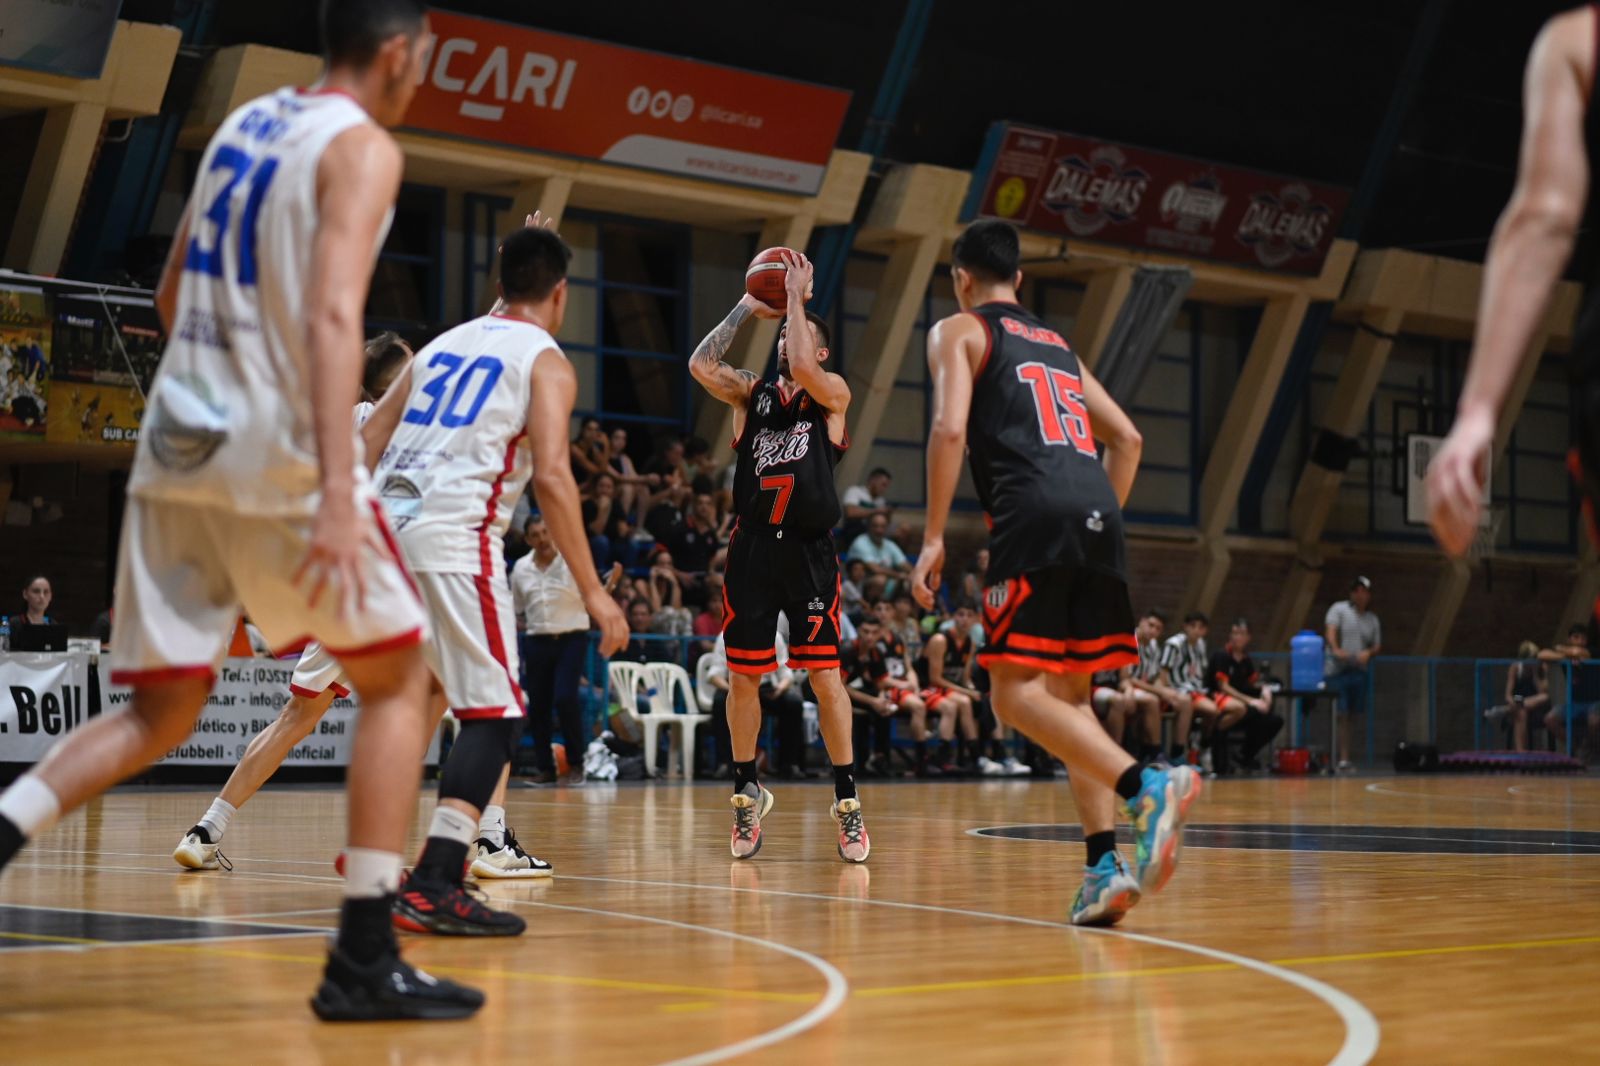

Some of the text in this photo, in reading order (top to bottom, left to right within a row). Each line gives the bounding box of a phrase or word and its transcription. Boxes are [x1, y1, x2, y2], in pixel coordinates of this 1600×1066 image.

[416, 32, 577, 110] ICARI
[184, 143, 279, 286] 31
[1045, 165, 1147, 215] DALEMAS
[1236, 200, 1331, 247] DALEMAS
[403, 351, 504, 429] 30
[1016, 361, 1098, 460] 15
[760, 473, 795, 525] 7
[808, 615, 824, 642] 7
[222, 668, 250, 682] Tel.:
[9, 685, 81, 736] Bell
[193, 717, 236, 734] tlético
[241, 721, 249, 738] y
[320, 720, 346, 735] Bell
[157, 744, 225, 762] clubbell
